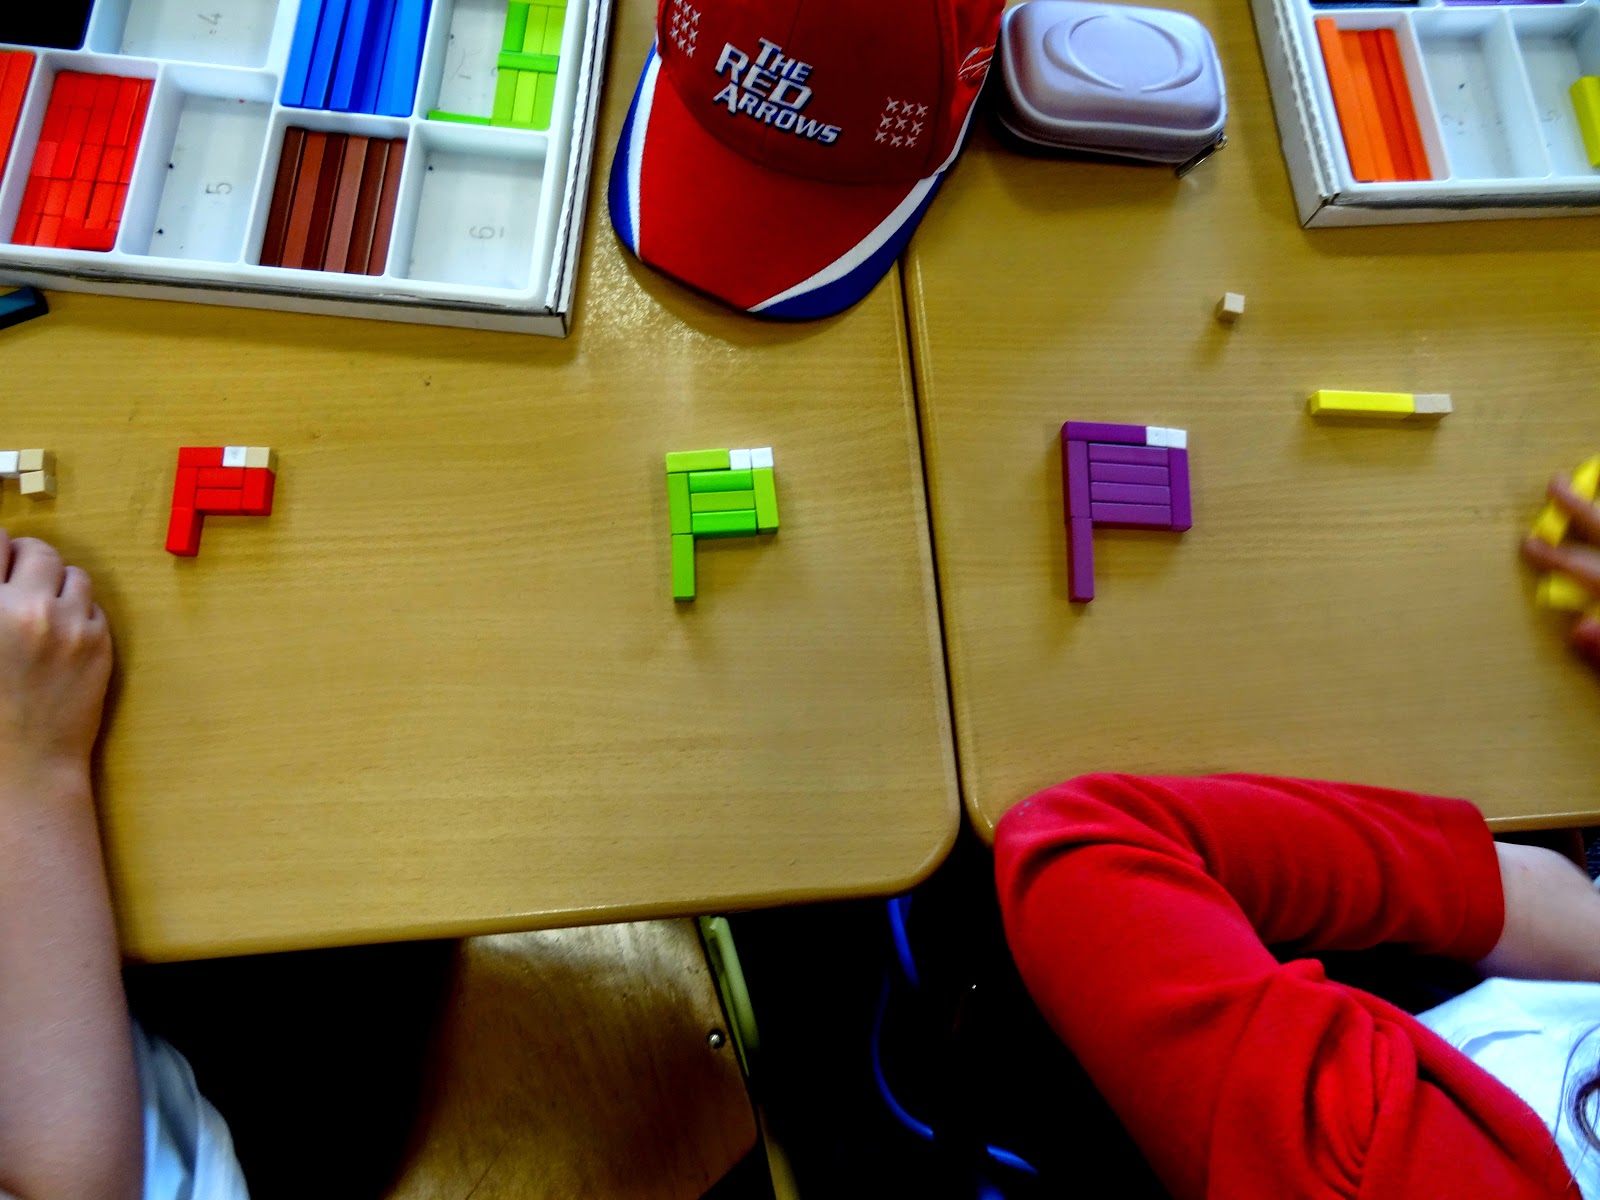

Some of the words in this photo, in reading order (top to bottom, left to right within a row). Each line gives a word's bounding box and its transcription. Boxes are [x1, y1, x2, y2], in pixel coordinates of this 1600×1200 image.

[714, 41, 813, 111] RED
[754, 36, 813, 83] THE
[712, 81, 842, 145] ARROWS
[205, 182, 232, 194] 5
